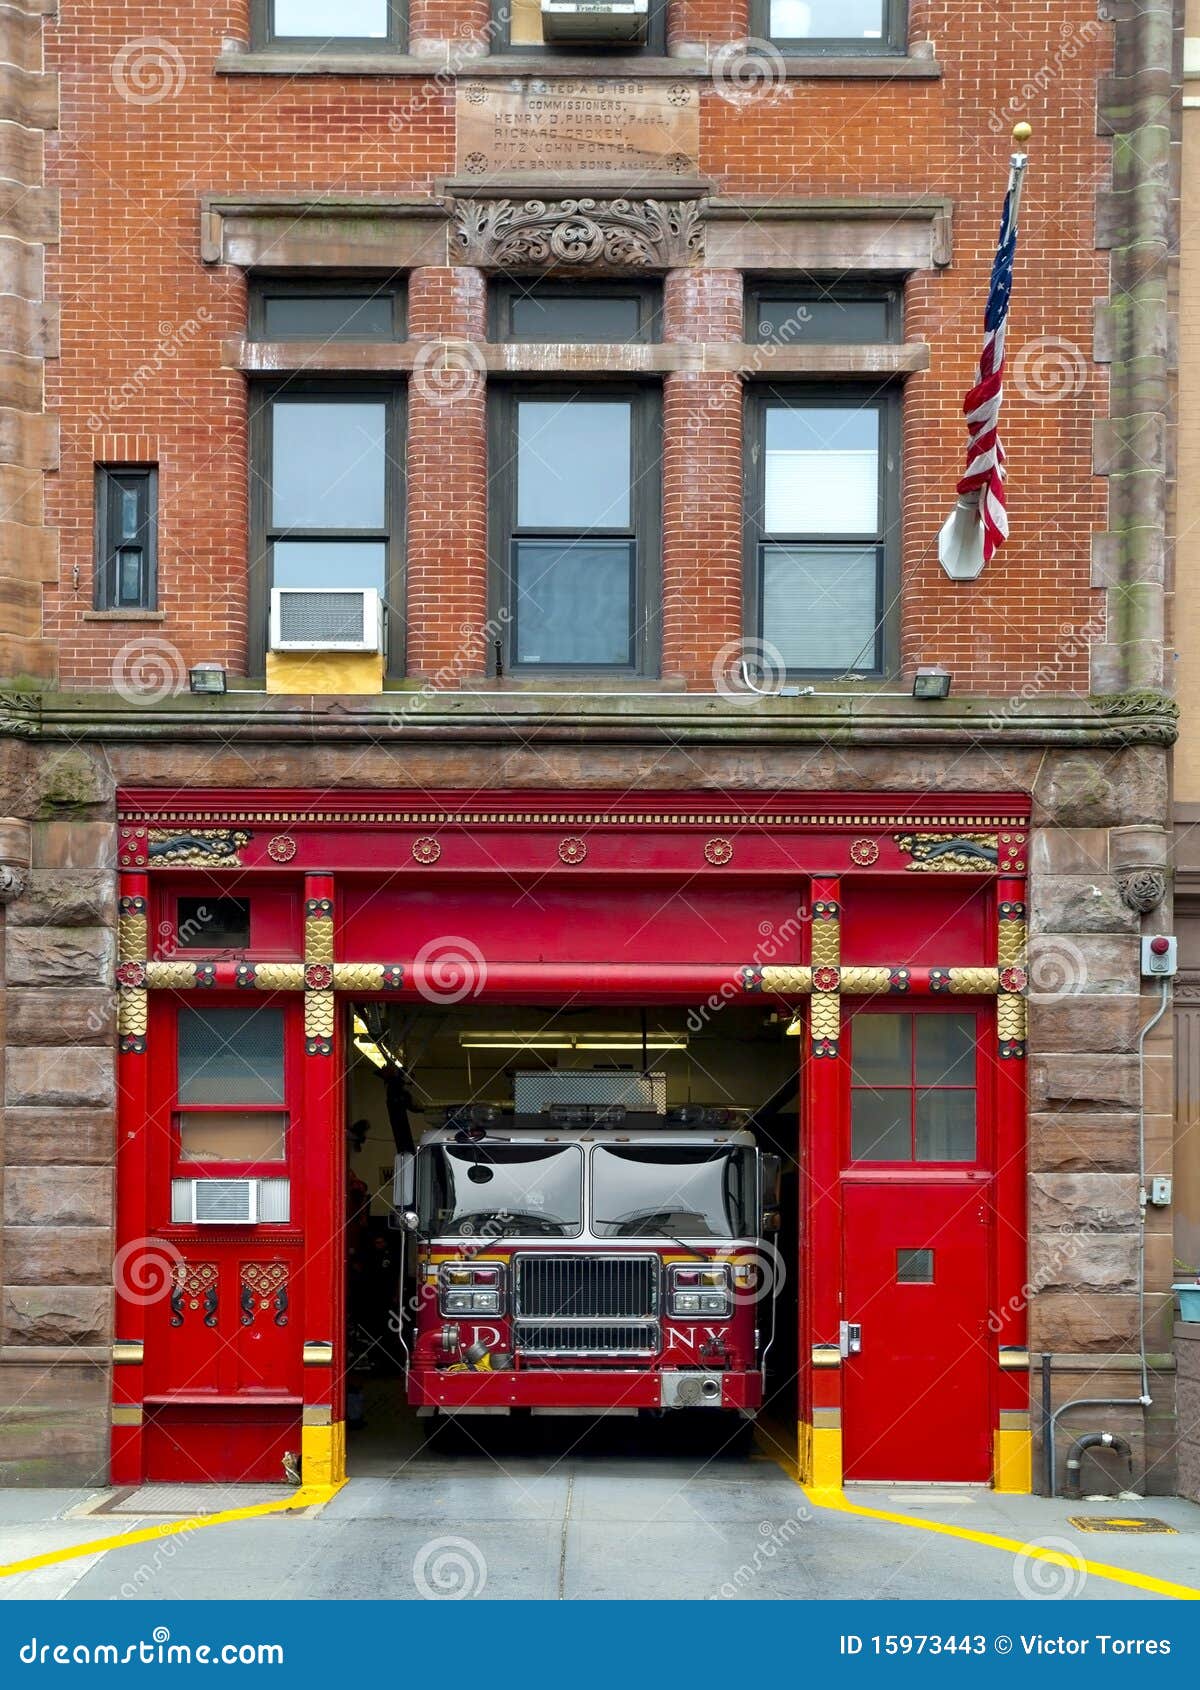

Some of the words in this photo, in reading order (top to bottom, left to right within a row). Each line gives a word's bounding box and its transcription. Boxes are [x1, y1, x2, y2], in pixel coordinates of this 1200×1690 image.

[495, 113, 543, 124] HENRY
[494, 128, 557, 139] RICHARD
[494, 142, 526, 153] FITZ
[535, 143, 573, 153] JOHN
